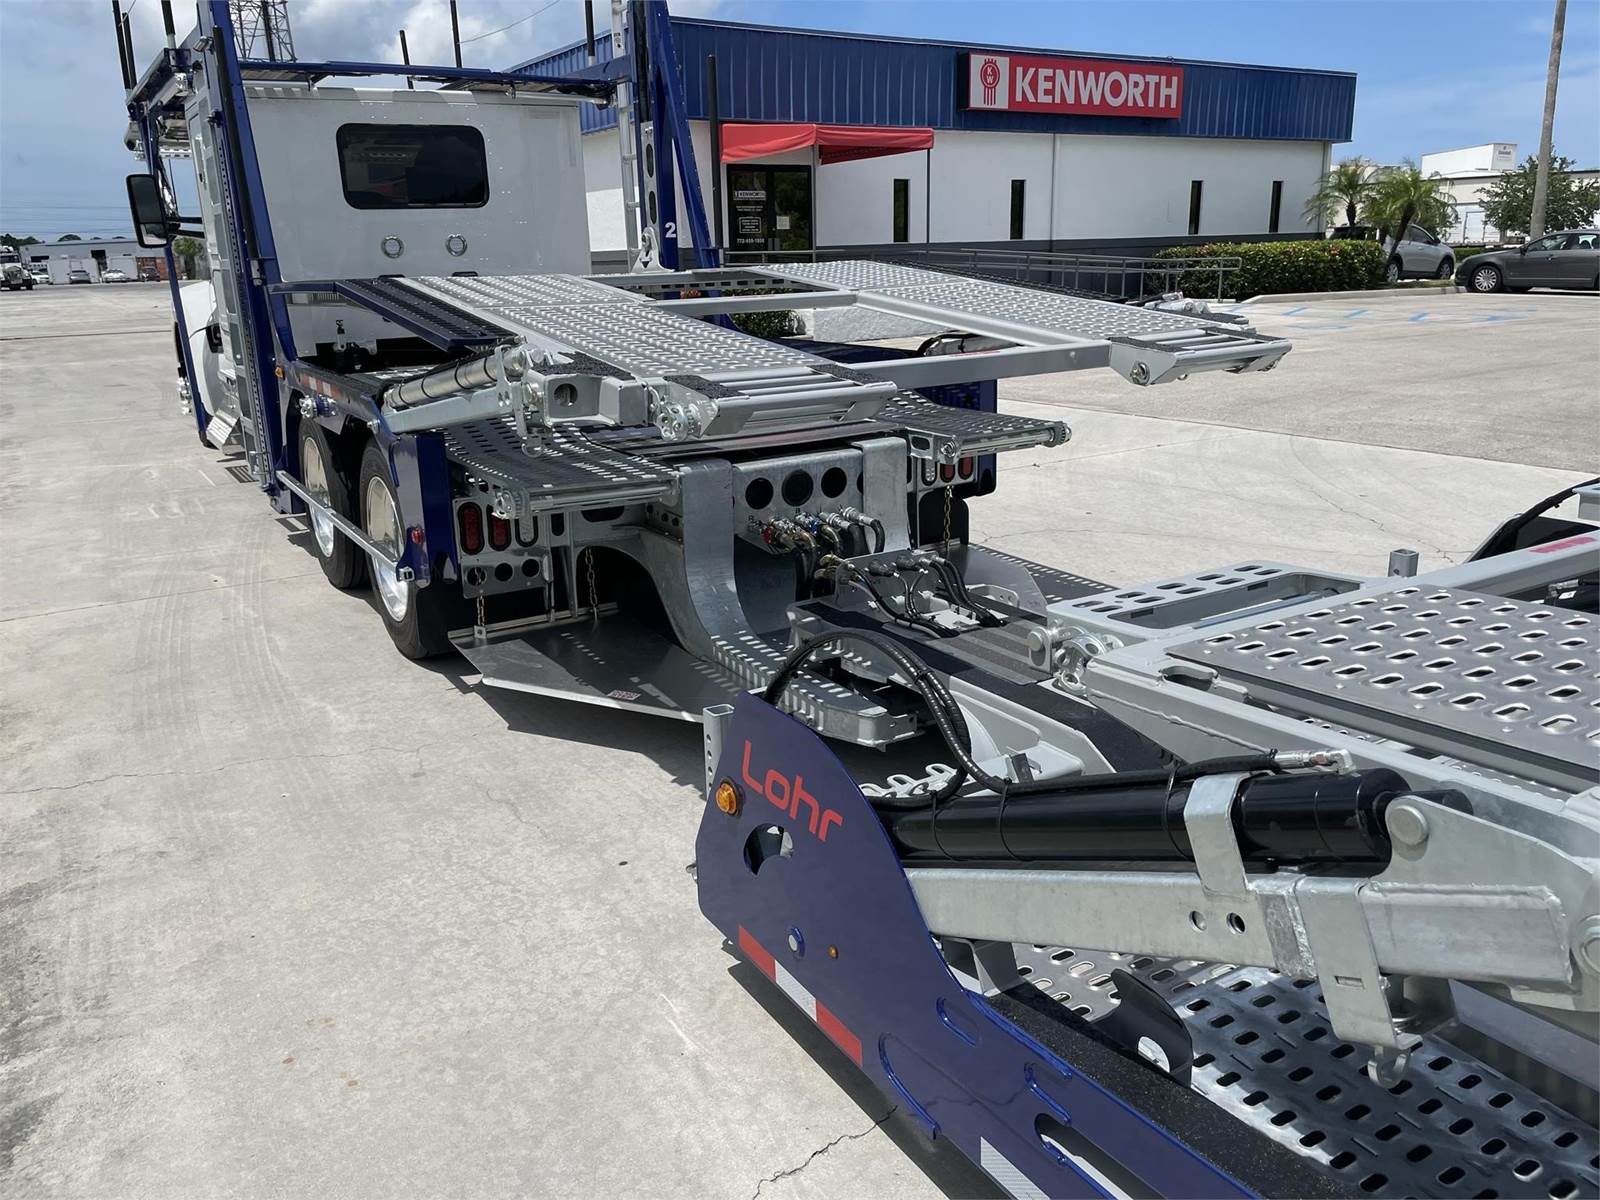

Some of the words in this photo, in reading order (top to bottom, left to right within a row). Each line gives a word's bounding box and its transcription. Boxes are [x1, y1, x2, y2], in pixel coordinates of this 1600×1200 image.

[1015, 66, 1178, 109] KENWORTH
[665, 222, 677, 238] 2
[743, 739, 843, 841] Lohr
